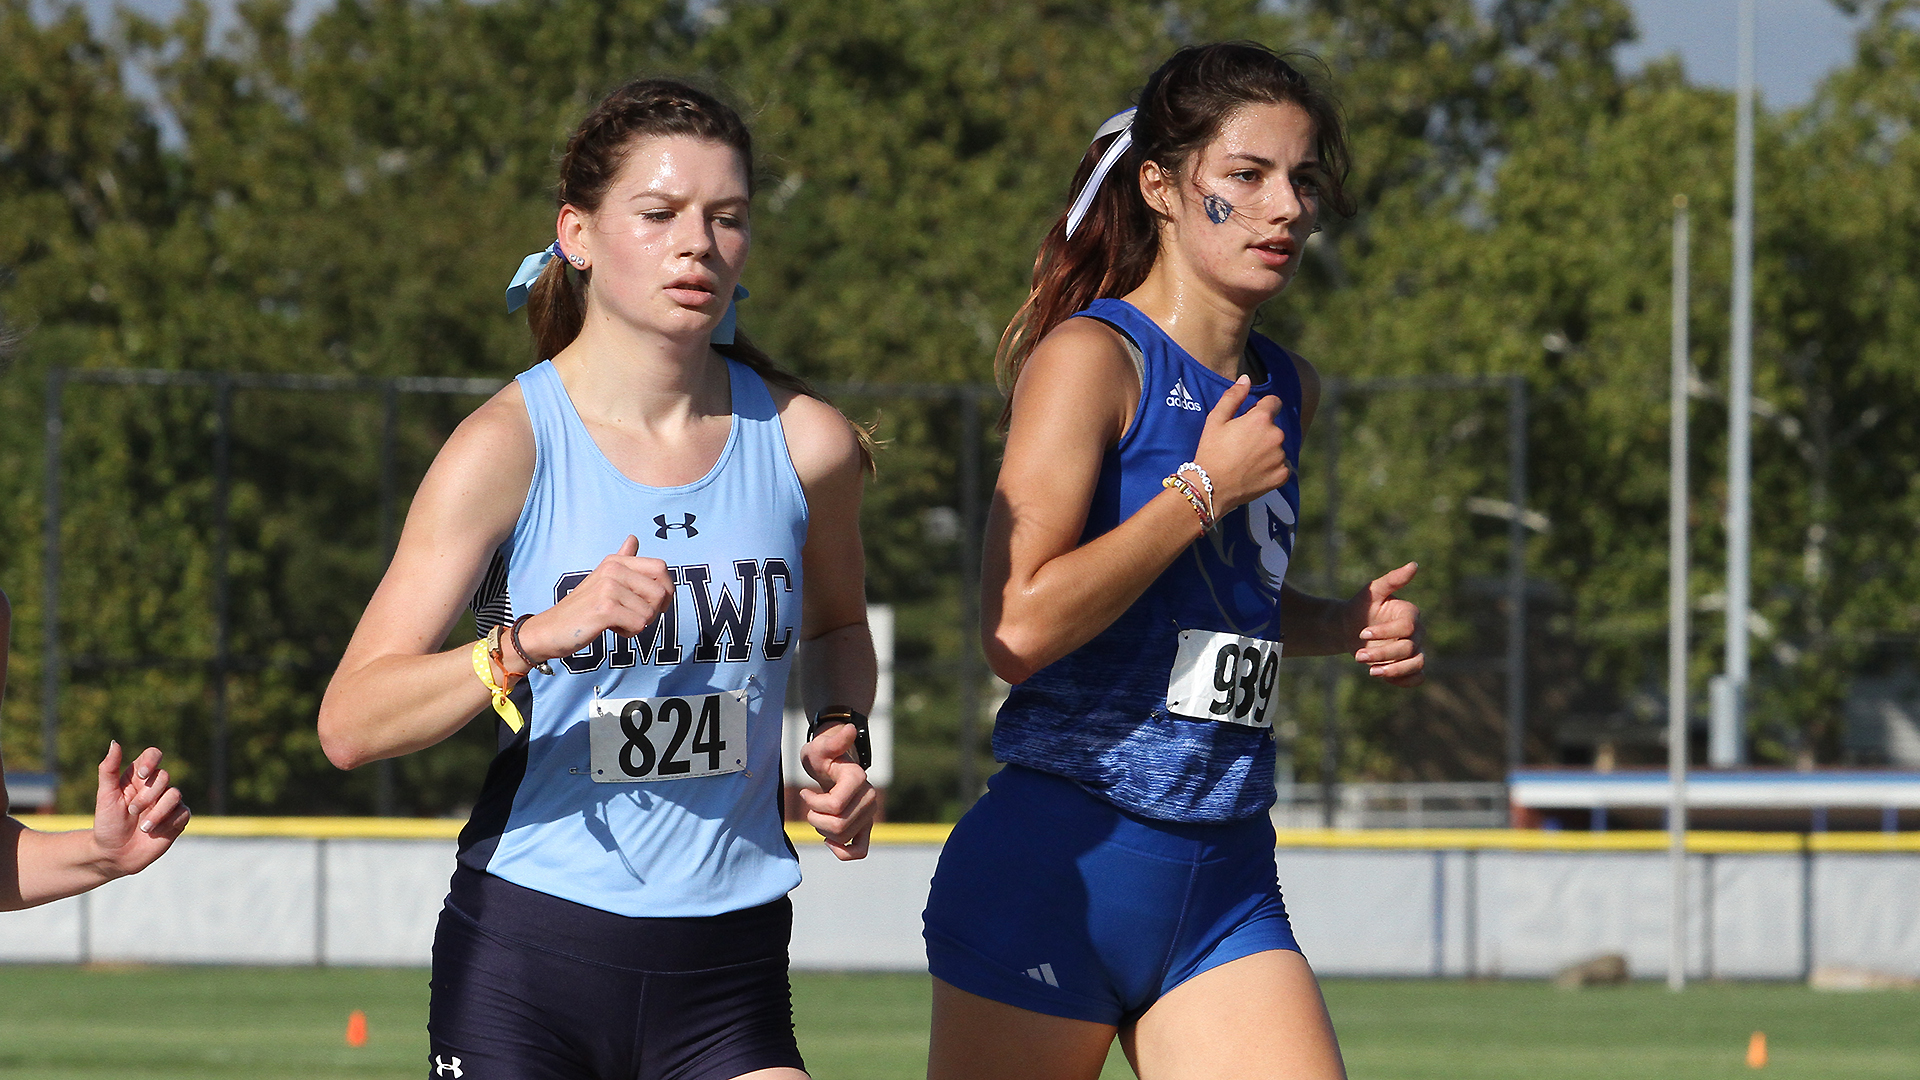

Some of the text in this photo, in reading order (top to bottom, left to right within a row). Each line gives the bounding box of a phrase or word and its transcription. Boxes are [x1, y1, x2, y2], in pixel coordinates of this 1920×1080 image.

[1166, 397, 1202, 412] addas
[1209, 643, 1278, 722] 939
[618, 694, 726, 778] 824
